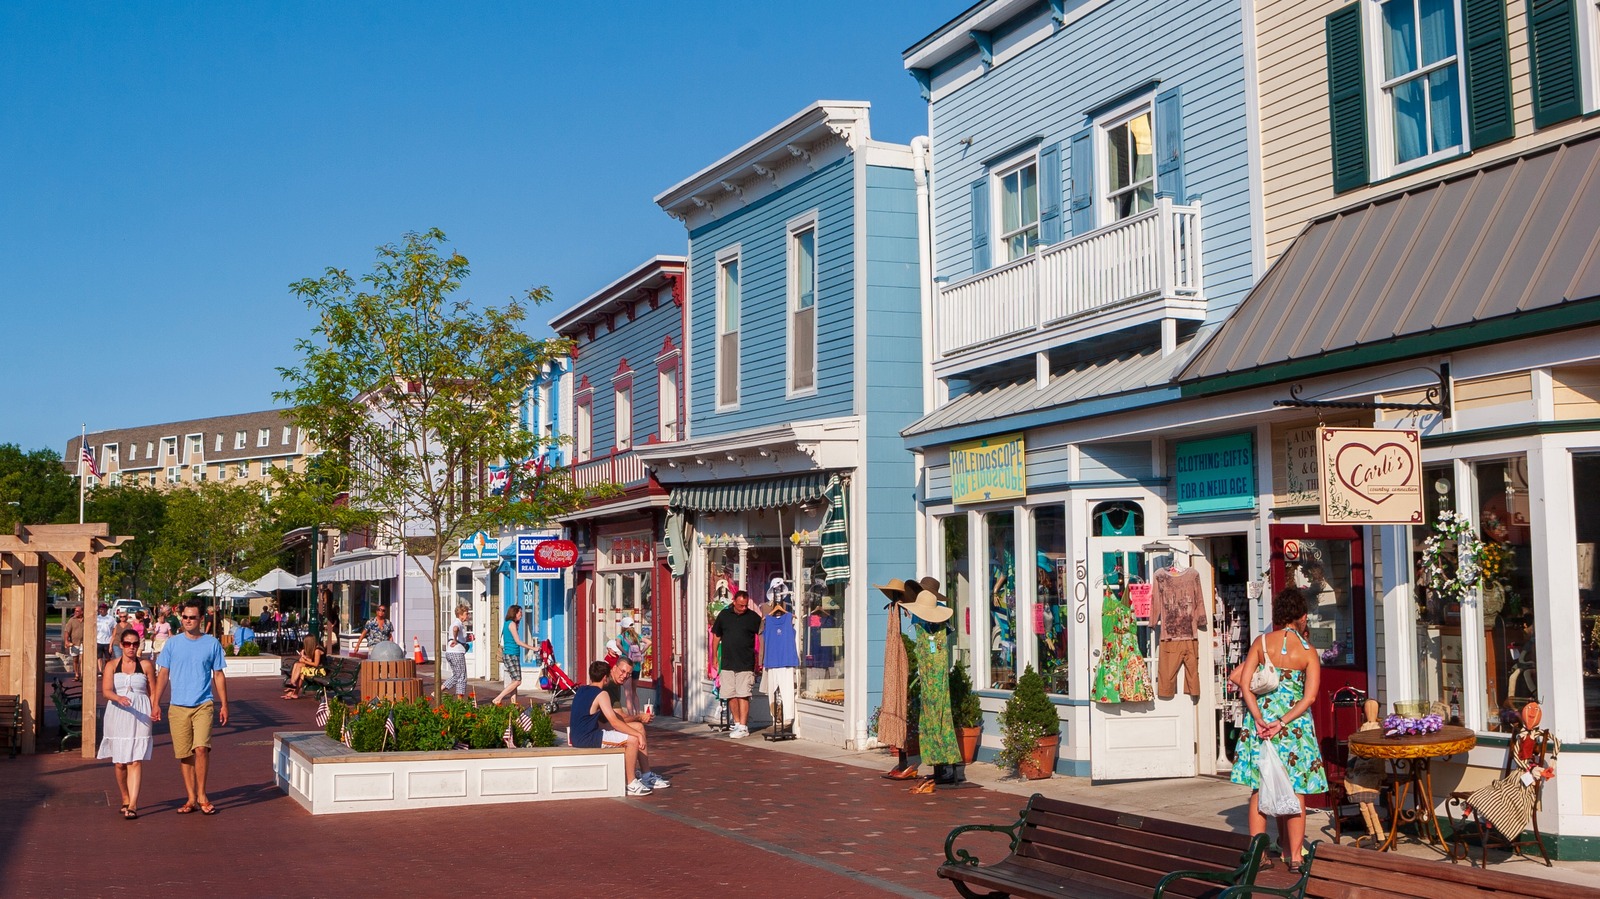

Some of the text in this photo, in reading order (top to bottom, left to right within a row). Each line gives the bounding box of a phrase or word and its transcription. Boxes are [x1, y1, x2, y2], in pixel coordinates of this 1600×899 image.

[1301, 429, 1316, 442] UNI
[951, 438, 1022, 475] KALEIDOSCOPE
[1177, 448, 1249, 473] CLOTHING GIFTS
[1298, 446, 1308, 459] OF
[1302, 462, 1308, 474] &
[1350, 449, 1404, 487] Carli's
[1181, 477, 1248, 499] FOR A NEW AGE
[1075, 559, 1087, 624] 506
